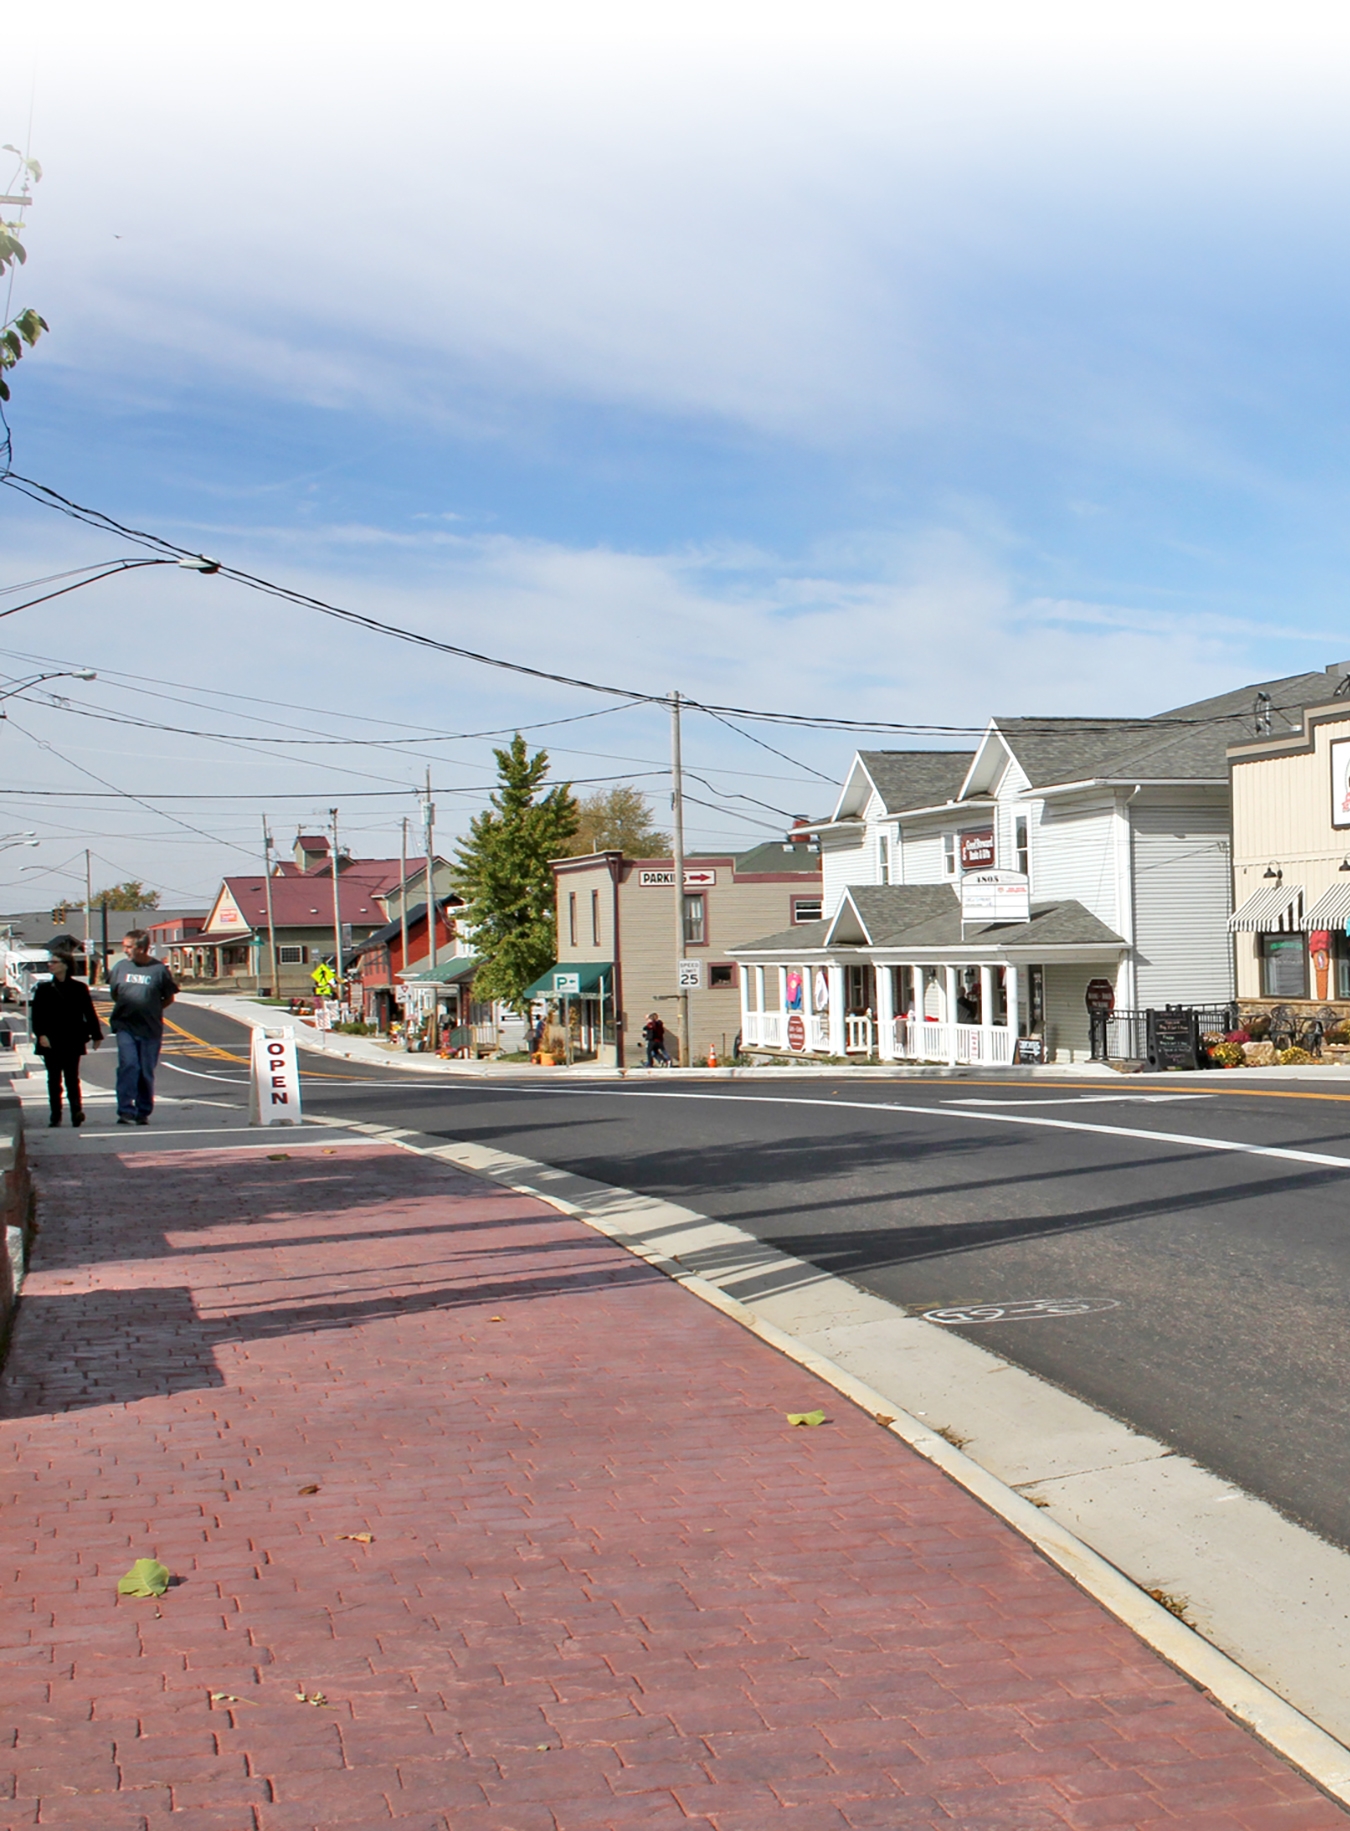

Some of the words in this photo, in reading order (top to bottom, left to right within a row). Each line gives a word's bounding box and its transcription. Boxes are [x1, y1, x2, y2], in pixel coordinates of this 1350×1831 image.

[643, 872, 687, 884] PARKIG
[124, 973, 152, 985] USMC
[556, 976, 567, 990] P
[680, 973, 699, 985] 25
[267, 1043, 289, 1105] OPEN
